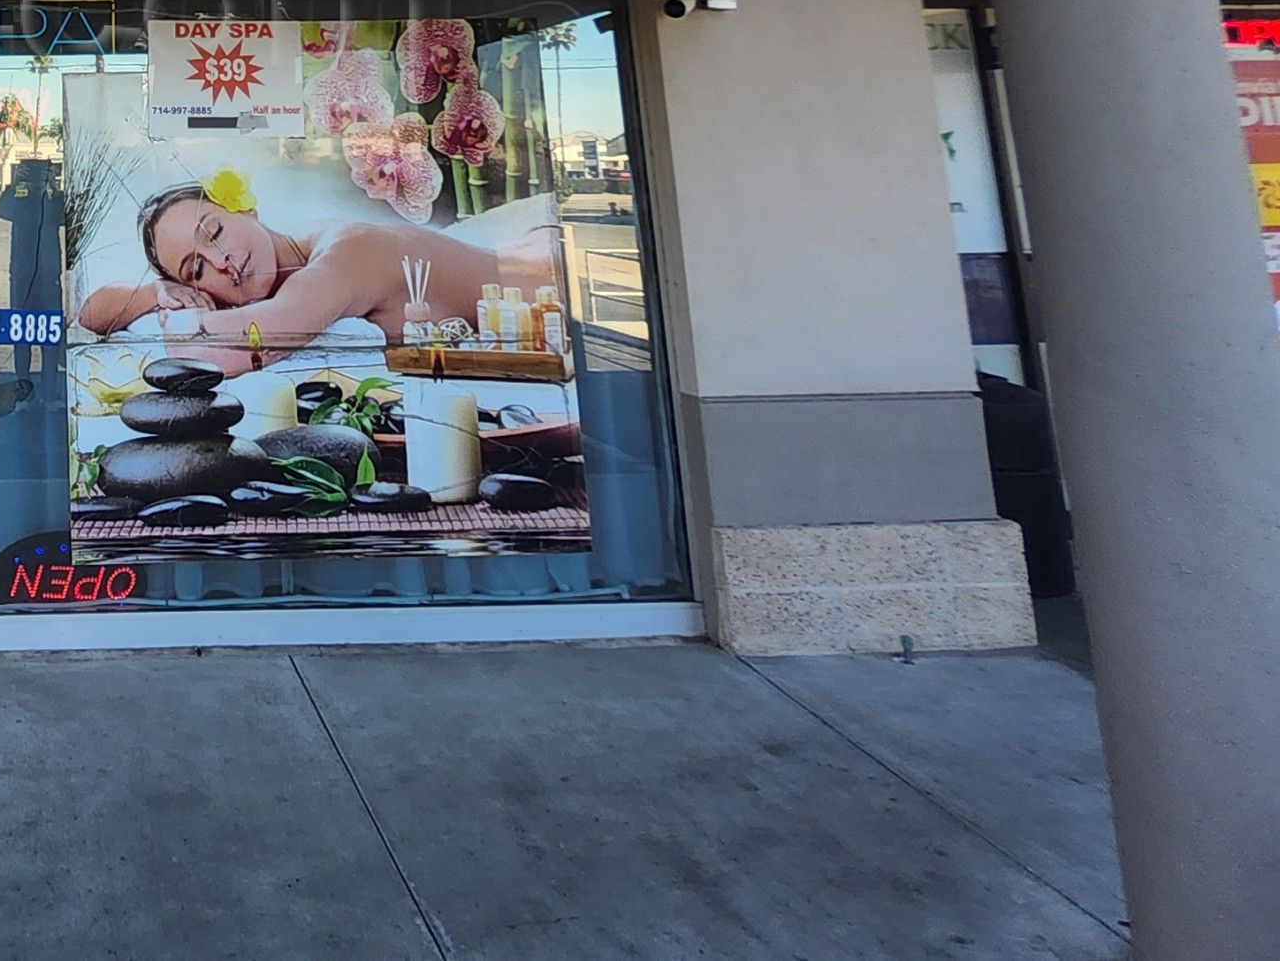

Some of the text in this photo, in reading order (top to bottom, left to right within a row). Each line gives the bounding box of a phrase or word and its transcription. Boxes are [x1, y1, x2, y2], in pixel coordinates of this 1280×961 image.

[175, 23, 273, 38] DAY SPA
[205, 57, 247, 84] $39
[152, 106, 212, 115] 714-997-8885
[253, 105, 269, 115] Half
[10, 564, 136, 600] OPEN
